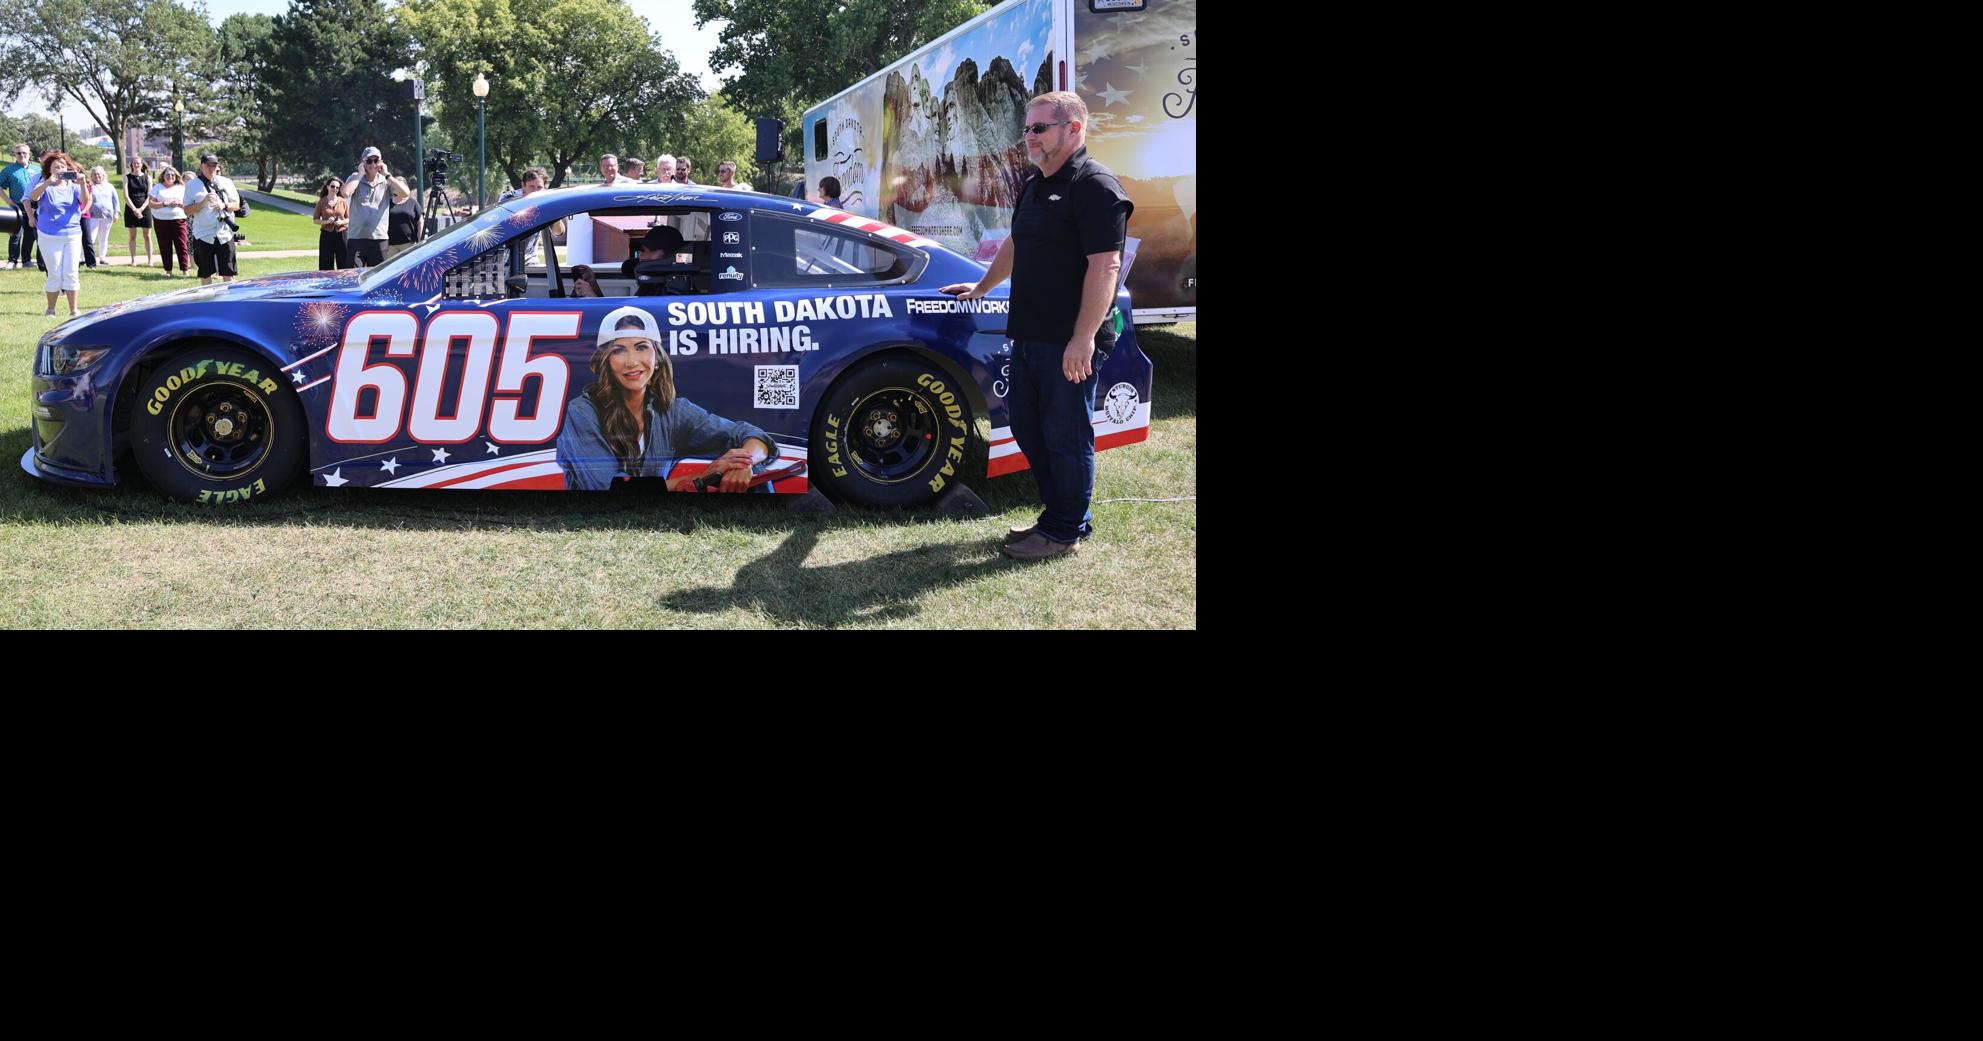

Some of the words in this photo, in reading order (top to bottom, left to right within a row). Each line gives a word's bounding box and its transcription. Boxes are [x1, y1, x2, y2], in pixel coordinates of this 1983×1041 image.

[667, 301, 765, 326] SOUTH
[774, 294, 893, 321] DAKOTA
[669, 329, 698, 355] IS
[708, 325, 820, 354] HIRING.
[325, 310, 583, 443] 605
[825, 413, 848, 478] EAGLE
[196, 478, 266, 504] EAGLE
